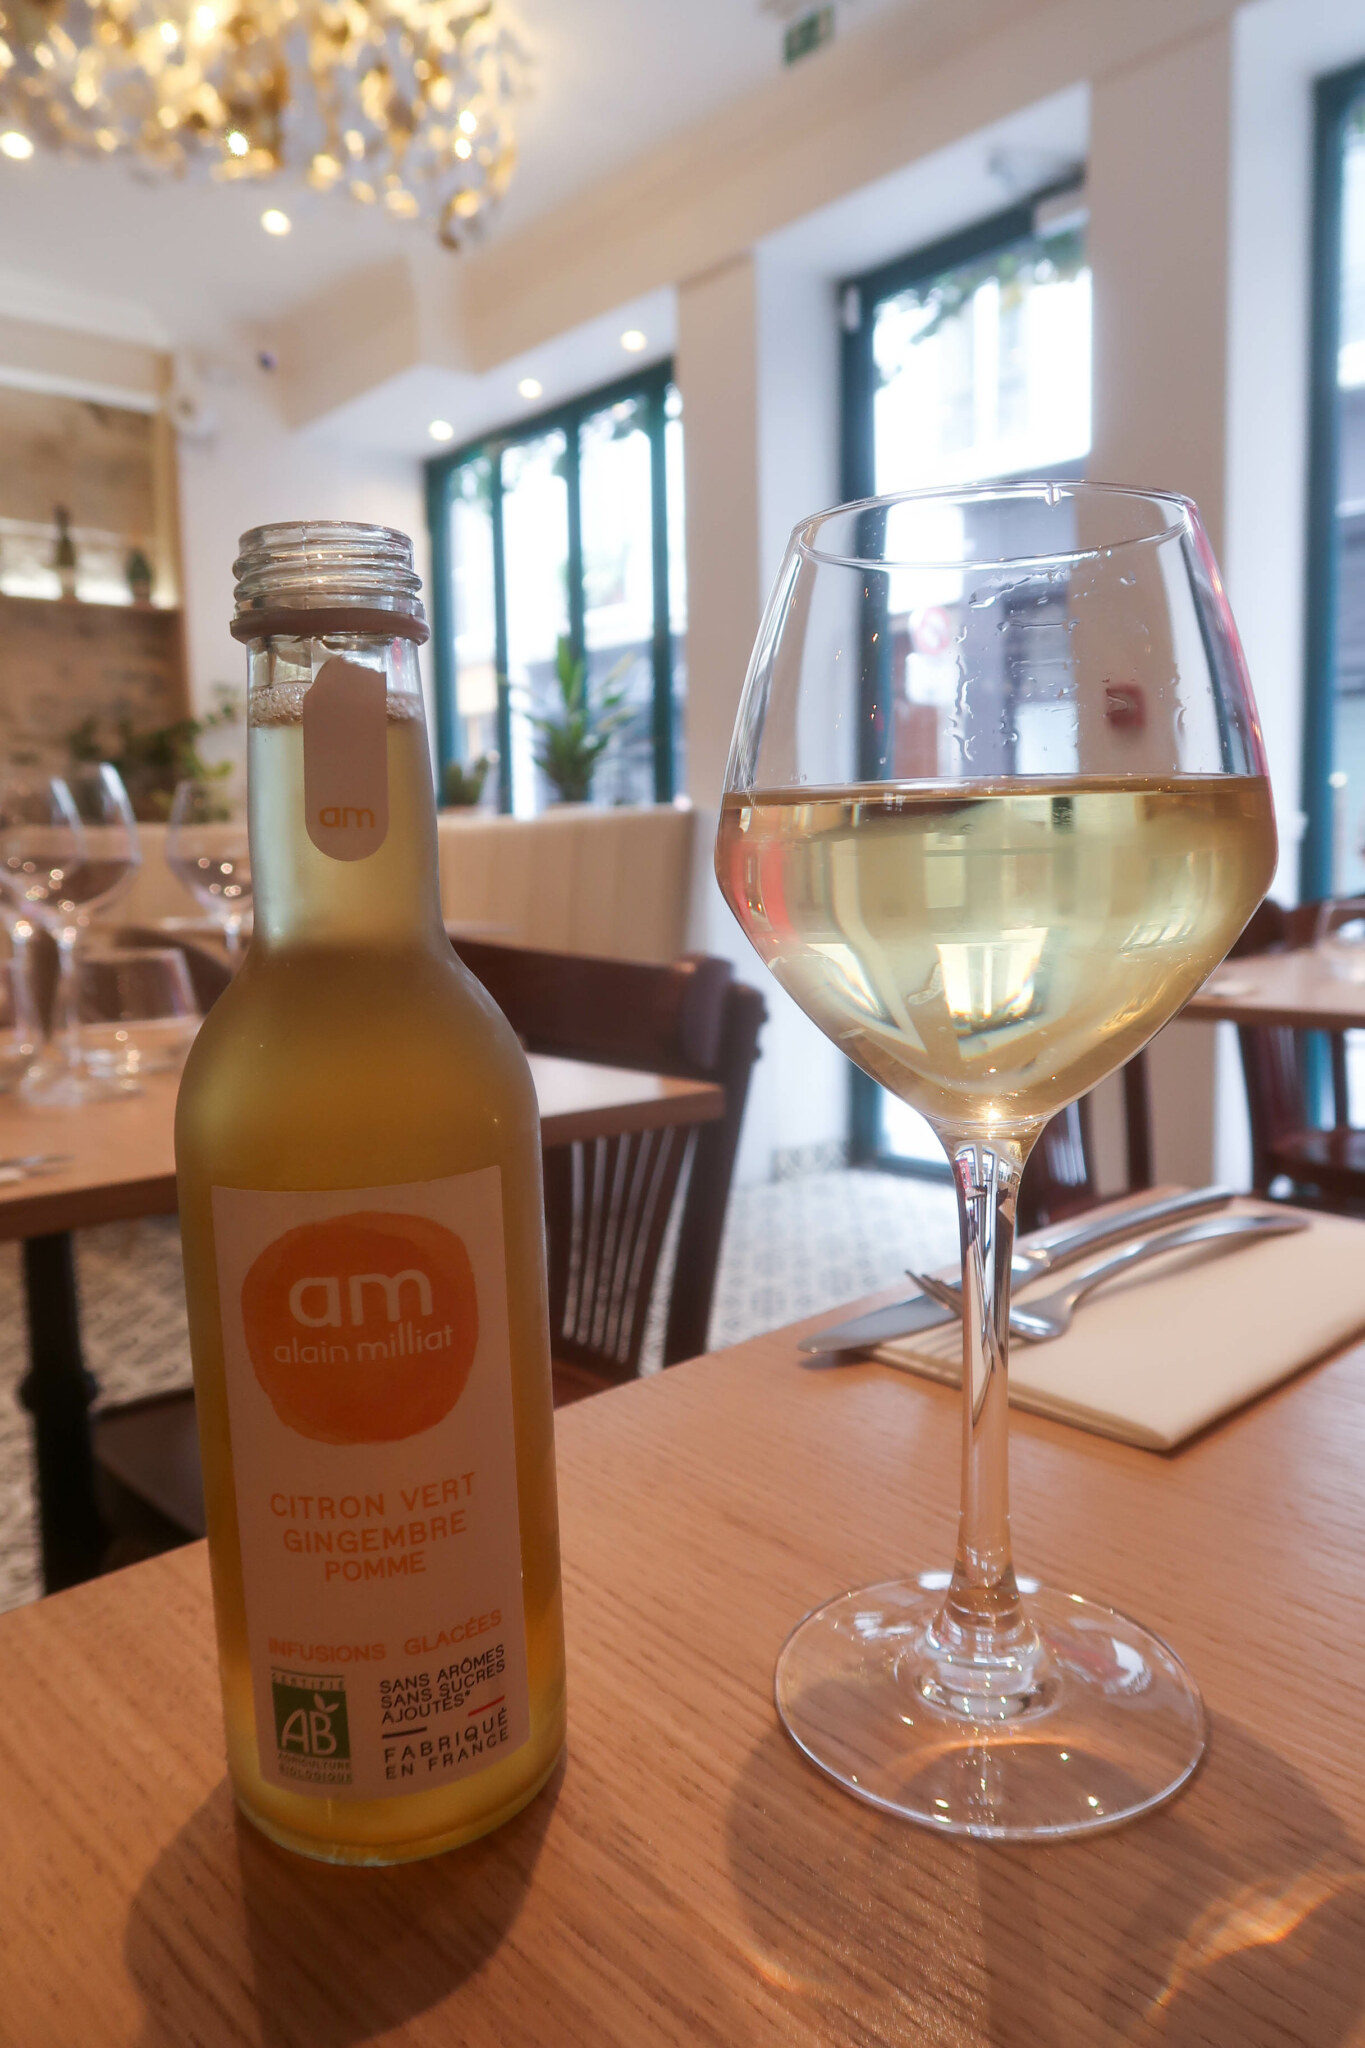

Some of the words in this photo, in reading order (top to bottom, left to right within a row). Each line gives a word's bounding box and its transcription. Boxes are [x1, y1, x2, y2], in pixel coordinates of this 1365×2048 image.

[319, 806, 375, 829] am
[289, 1269, 433, 1327] am
[274, 1337, 349, 1364] alain
[356, 1321, 453, 1361] milliat
[270, 1493, 384, 1520] CITRON
[400, 1472, 475, 1512] VERT
[283, 1510, 467, 1553] GINGEMBRE
[325, 1551, 426, 1582] POMME
[268, 1637, 386, 1663] INFUSIONS
[404, 1609, 502, 1656] GLACÉES
[380, 1673, 430, 1694] SANS
[437, 1644, 504, 1682] ARÔMES
[381, 1688, 432, 1709] SANS
[440, 1659, 505, 1697] SUCRES
[281, 1708, 337, 1756] AB
[384, 1707, 508, 1763] FABRIQUÉ
[386, 1763, 414, 1780] EN
[429, 1727, 509, 1771] FRANCE
